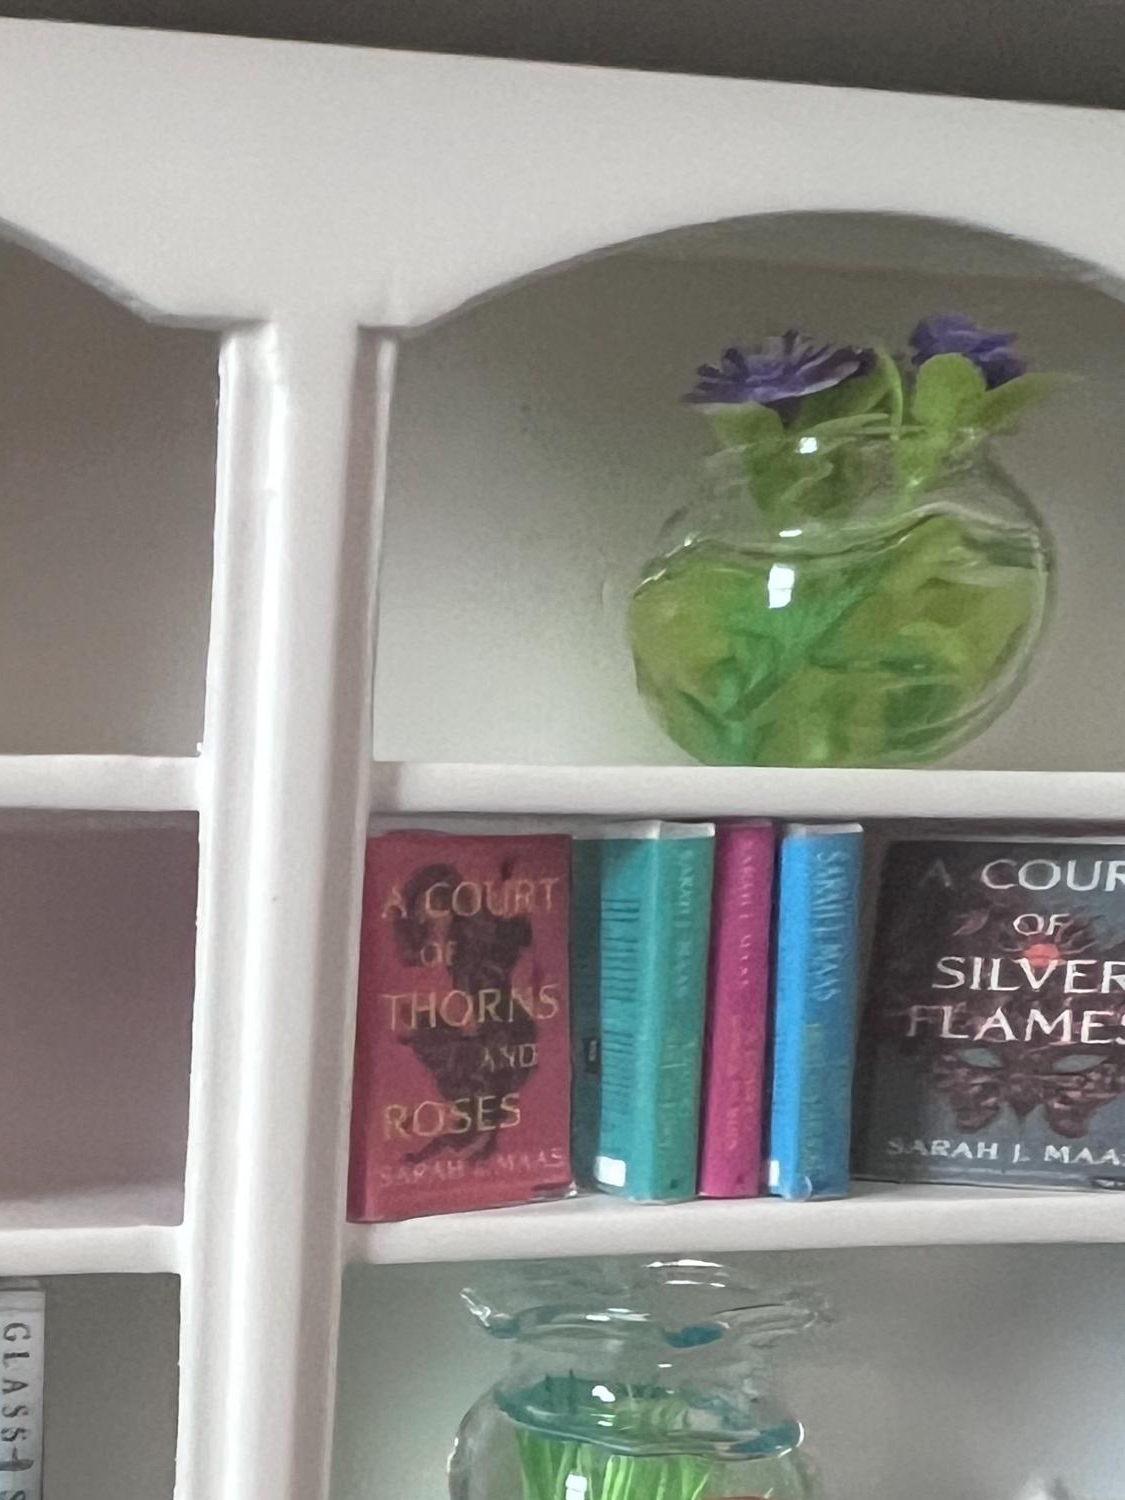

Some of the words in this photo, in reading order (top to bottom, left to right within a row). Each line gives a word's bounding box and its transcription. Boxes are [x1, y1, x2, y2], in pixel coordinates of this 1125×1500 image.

[925, 859, 952, 887] A
[381, 886, 407, 918] A
[424, 877, 559, 917] COURT
[1013, 912, 1070, 936] OF
[420, 940, 458, 967] OF
[381, 983, 560, 1030] THORNS
[905, 1004, 1125, 1045] FLAME
[480, 1043, 538, 1072] AND
[384, 1092, 521, 1141] ROSES
[888, 1138, 999, 1160] SARAH
[1043, 1144, 1125, 1166] MAA
[0, 1320, 32, 1444] GLASS
